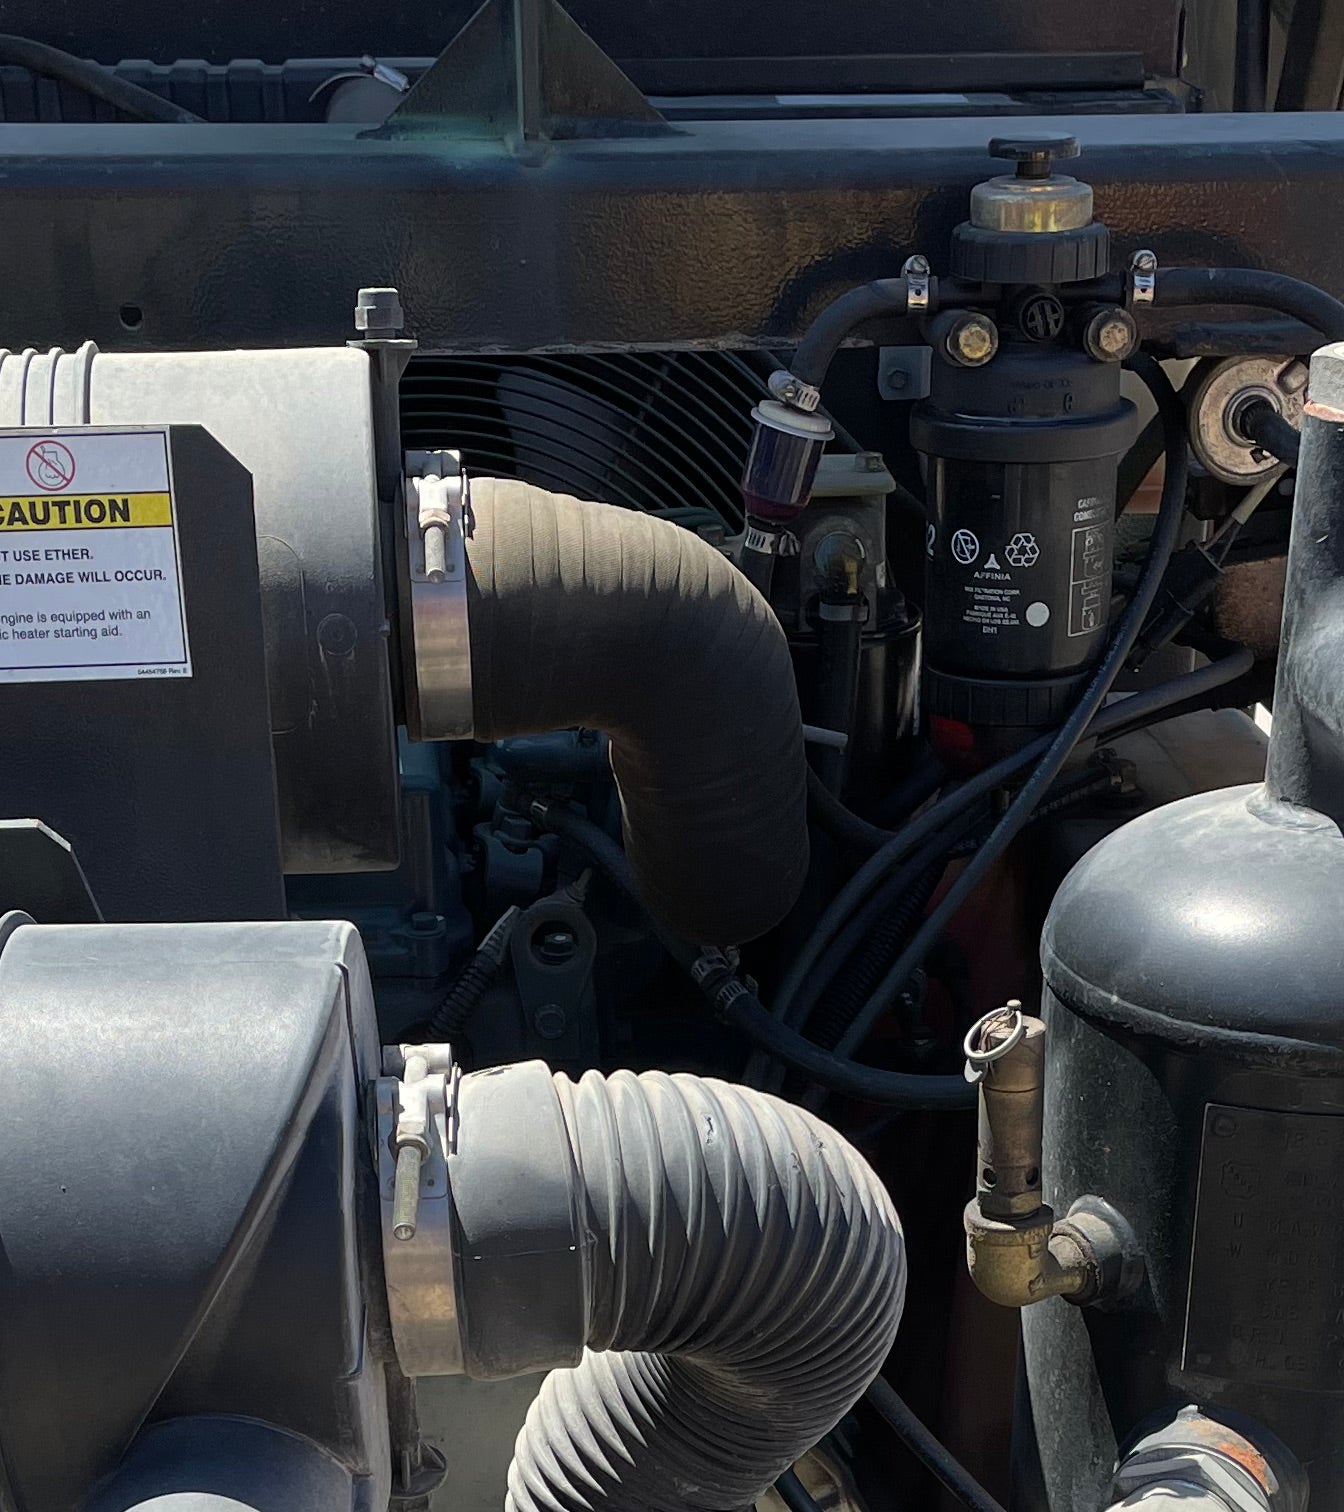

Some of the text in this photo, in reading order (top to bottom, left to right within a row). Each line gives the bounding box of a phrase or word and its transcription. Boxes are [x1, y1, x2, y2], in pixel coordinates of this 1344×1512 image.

[13, 549, 41, 562] USE
[44, 548, 94, 561] ETHER.
[14, 572, 75, 585] DAMAGE
[77, 571, 111, 584] WILL
[113, 569, 167, 583] OCCUR.
[36, 612, 47, 624] is
[50, 610, 106, 625] equipped
[108, 608, 133, 621] with
[136, 609, 152, 620] an
[12, 627, 49, 640] heater
[53, 625, 98, 640] starting
[100, 624, 124, 637] aid.
